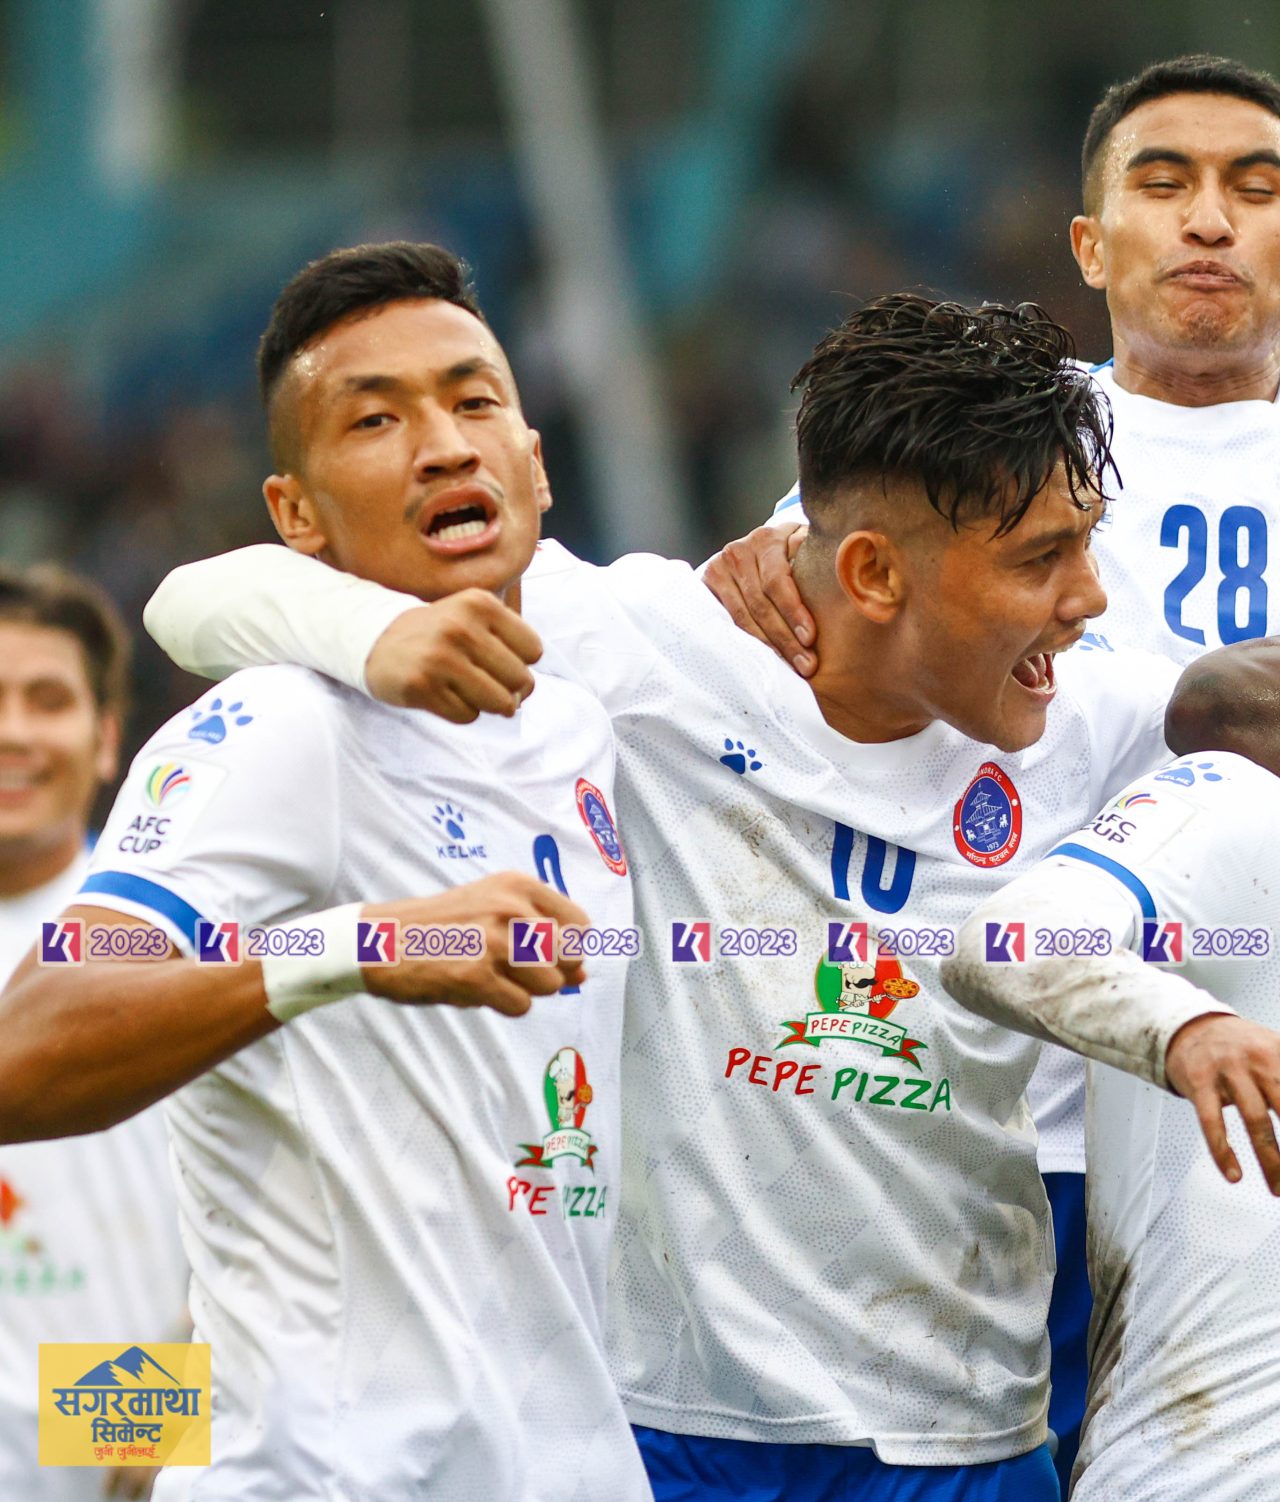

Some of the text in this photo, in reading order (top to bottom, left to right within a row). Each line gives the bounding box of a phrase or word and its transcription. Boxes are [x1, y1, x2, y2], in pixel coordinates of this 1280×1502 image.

[1160, 504, 1268, 646] 28
[127, 815, 172, 835] AFC
[118, 836, 162, 854] CUP
[437, 844, 488, 859] KELME
[811, 1017, 901, 1046] PEPE PIZZA
[724, 1047, 951, 1113] PEPE PIZZA
